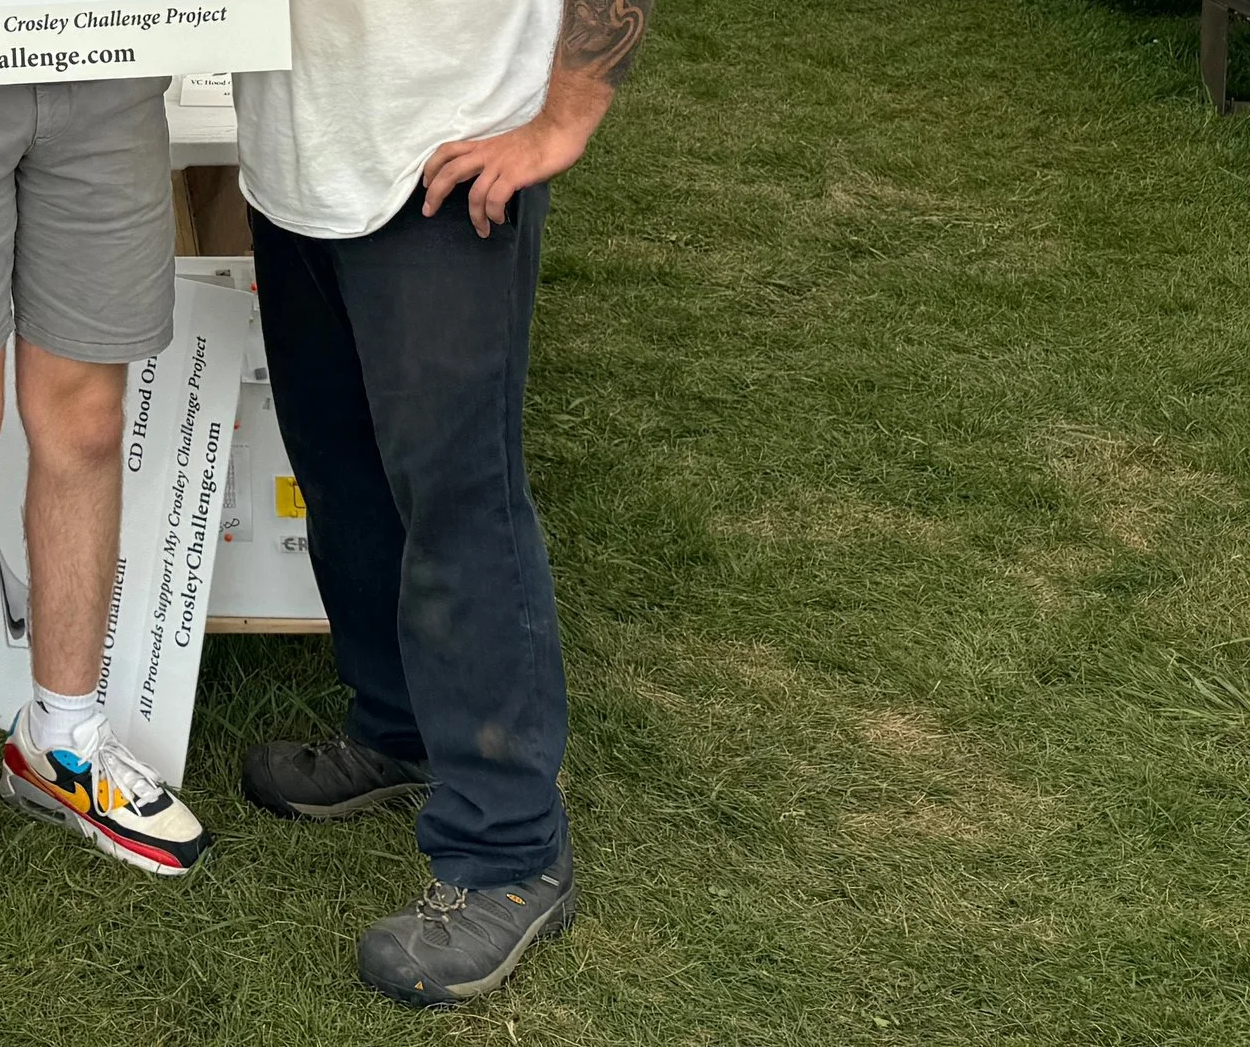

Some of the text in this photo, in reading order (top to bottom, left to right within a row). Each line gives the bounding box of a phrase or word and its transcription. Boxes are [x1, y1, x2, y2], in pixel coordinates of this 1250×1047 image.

[3, 13, 69, 35] Crosley
[74, 10, 161, 31] Challenge
[165, 6, 228, 28] Project
[132, 388, 152, 439] Hood
[127, 443, 144, 473] CD
[139, 335, 209, 722] All Proceeds Support My Crosley Challenge Project
[174, 421, 222, 648] CrosleyChallenge.com
